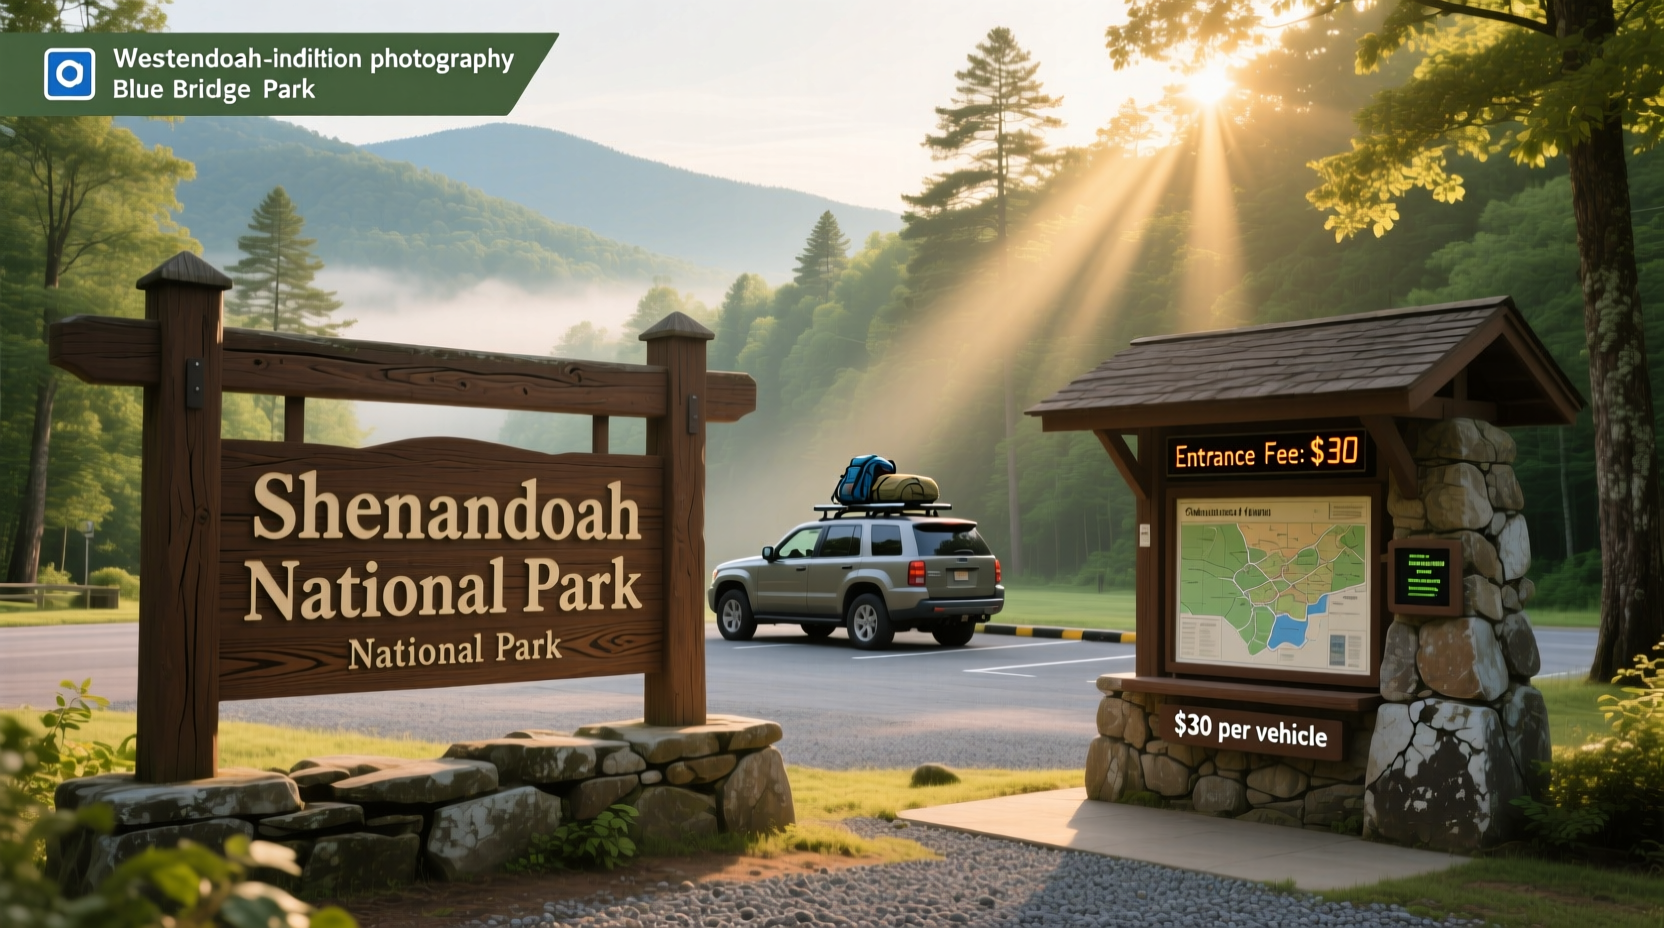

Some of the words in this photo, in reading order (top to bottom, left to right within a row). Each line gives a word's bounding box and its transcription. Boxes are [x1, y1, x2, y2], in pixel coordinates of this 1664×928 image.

[1175, 445, 1256, 468] Entrance
[1264, 441, 1305, 466] Fee:
[1310, 435, 1359, 467] $30
[253, 469, 642, 541] Shenandoah
[243, 555, 508, 621] National
[523, 555, 643, 613] Park
[348, 632, 484, 670] National
[495, 629, 563, 661] Park
[1174, 709, 1213, 738] $30
[1218, 721, 1252, 743] per
[1255, 721, 1328, 748] vehicle
